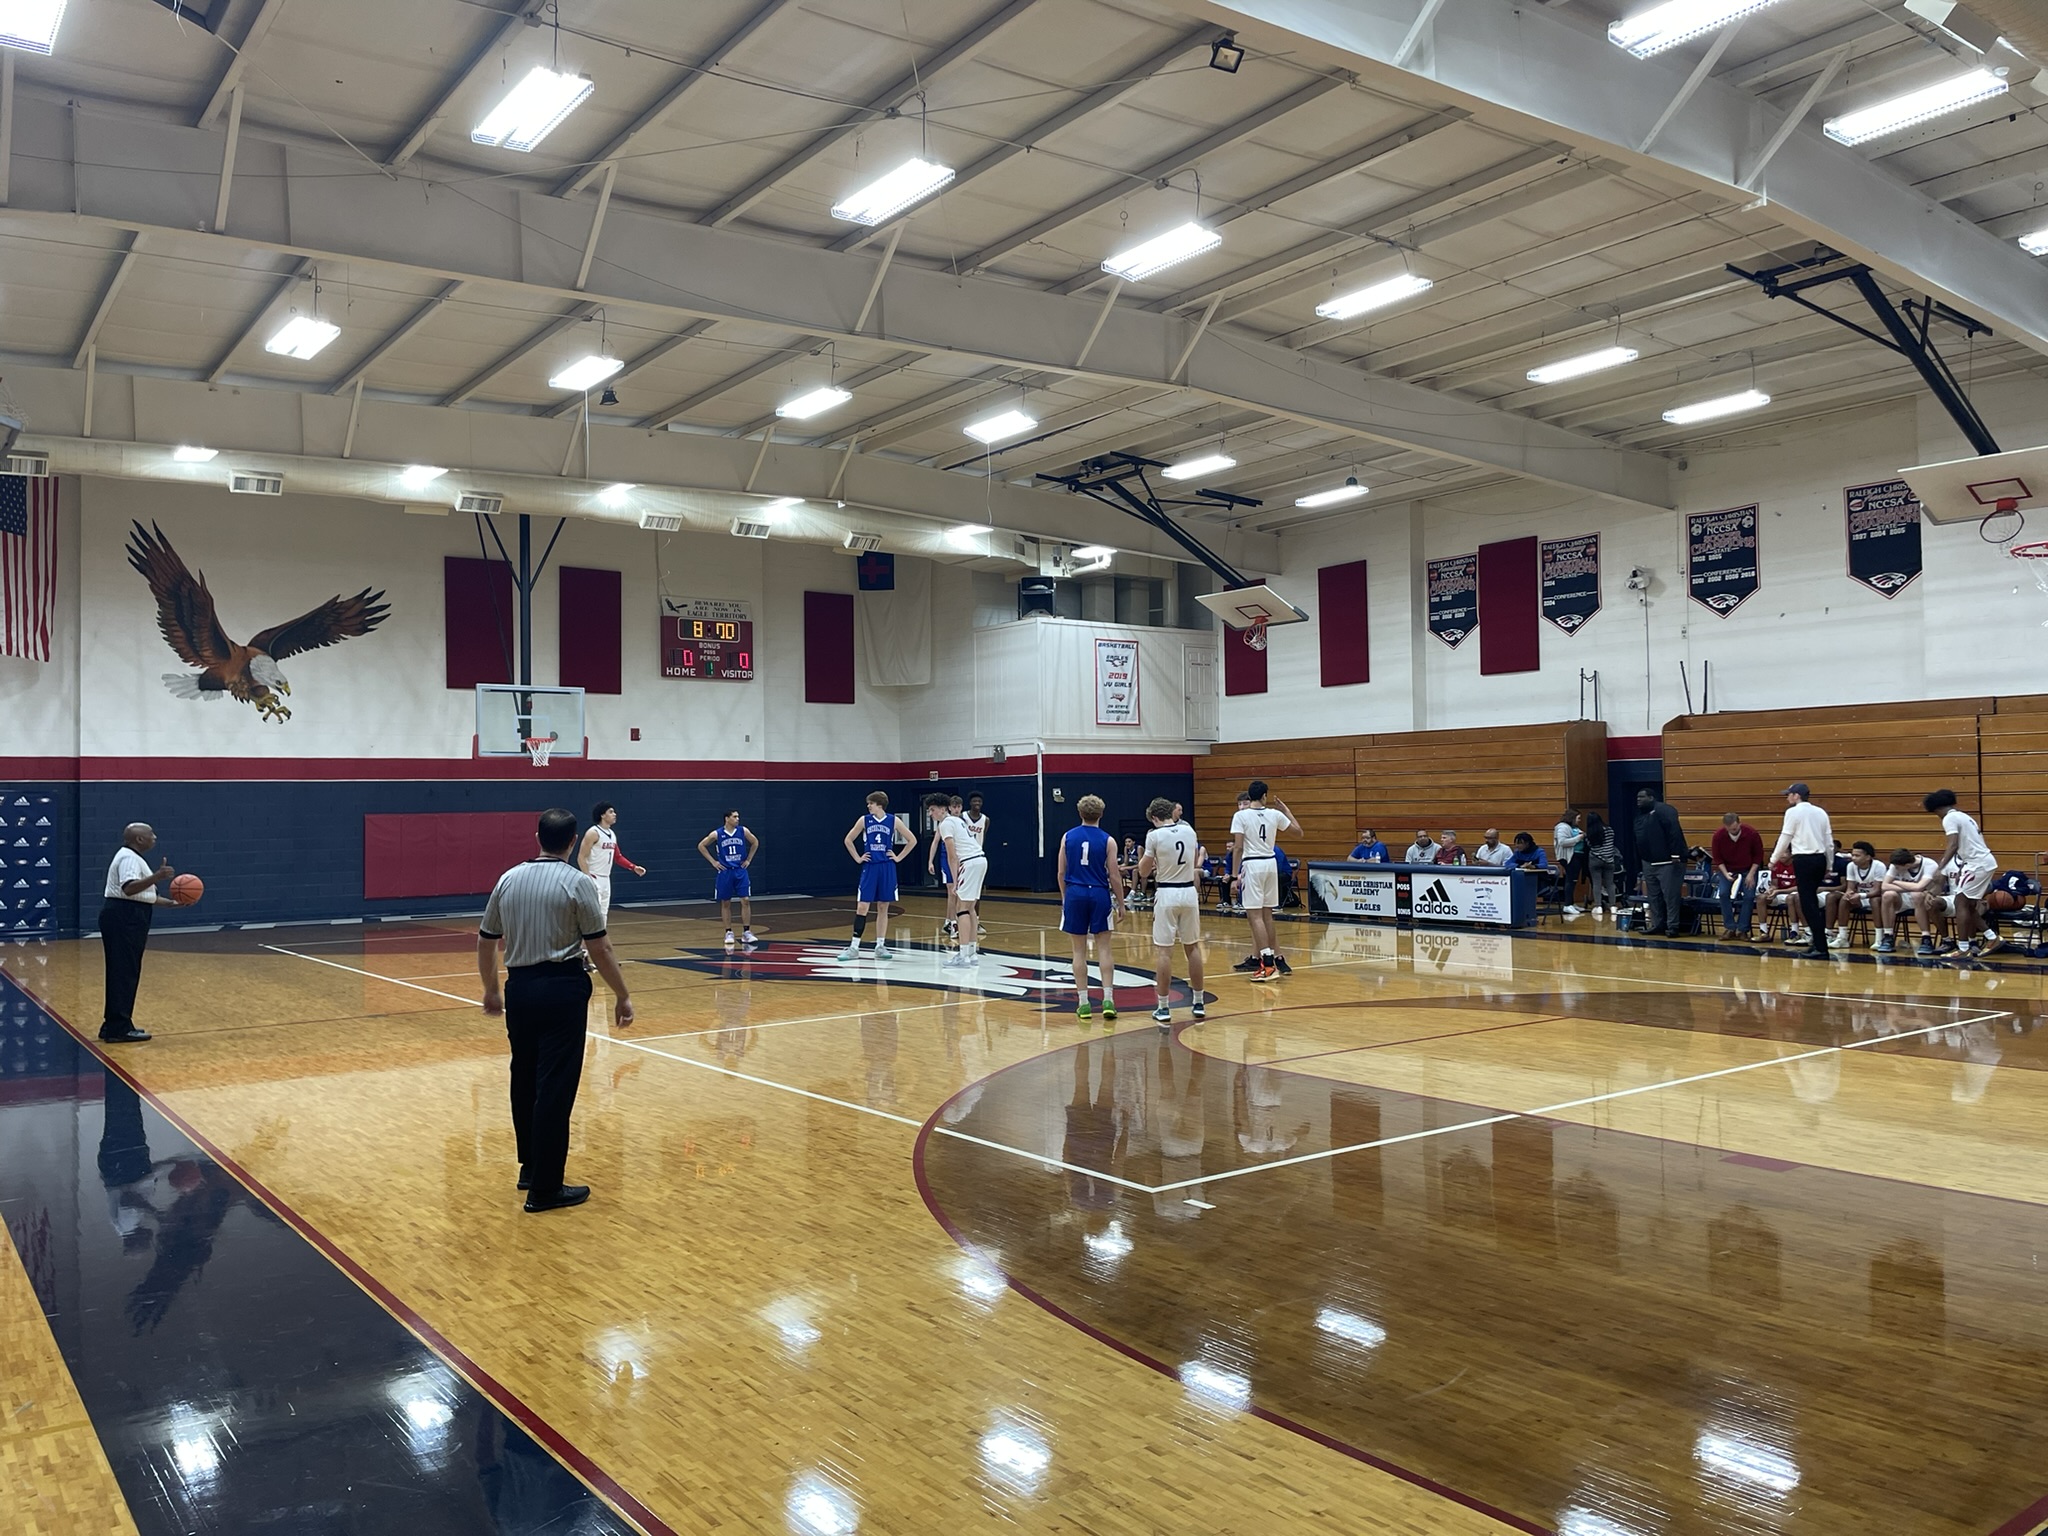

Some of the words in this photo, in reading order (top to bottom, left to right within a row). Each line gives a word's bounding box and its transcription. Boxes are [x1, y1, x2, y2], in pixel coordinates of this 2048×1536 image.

[1849, 488, 1881, 498] RALEIGH
[1883, 483, 1908, 493] CHRIS
[1868, 498, 1904, 509] NCCSA
[1691, 516, 1718, 524] RALEIGH
[1720, 509, 1754, 520] CHRISTIAN
[1707, 524, 1737, 534] NCCSA
[1691, 536, 1755, 555] CHAMPIONS
[1557, 552, 1583, 561] NCCSA
[1441, 570, 1464, 580] NCCSA
[1703, 568, 1742, 577] CONFERENCE
[666, 667, 696, 676] HOME
[721, 670, 753, 678] VISITOR
[1259, 824, 1266, 842] 4
[875, 834, 881, 843] 4
[729, 846, 736, 854] 11
[1081, 841, 1090, 866] 1
[1176, 841, 1186, 866] 2
[608, 852, 611, 864] 1
[1363, 881, 1393, 889] CHRISTIAN
[1352, 888, 1380, 896] ACADEMY
[1355, 903, 1381, 911] EAGLES
[1414, 901, 1458, 915] adidas
